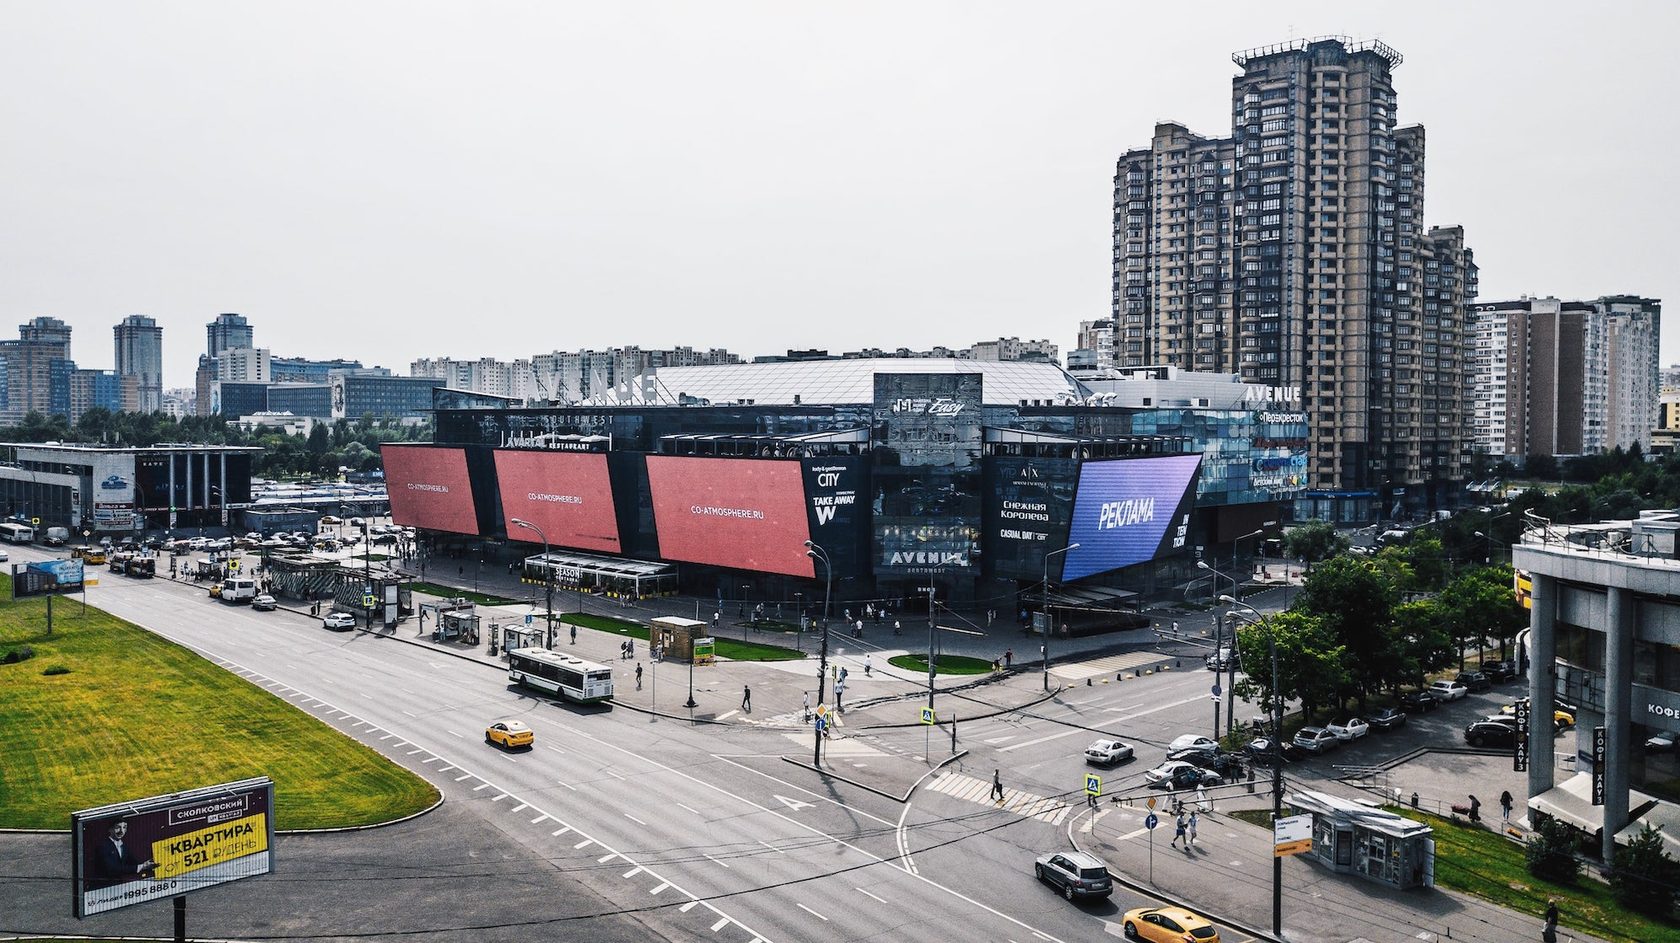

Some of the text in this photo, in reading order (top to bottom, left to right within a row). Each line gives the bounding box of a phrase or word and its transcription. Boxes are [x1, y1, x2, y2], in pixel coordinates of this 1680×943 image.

[1245, 387, 1301, 402] AVENUE
[928, 398, 965, 416] Easy
[544, 415, 614, 425] SOUTHWEST
[818, 473, 840, 487] CITY
[407, 483, 449, 493] CO-ATMOSPHERE.RU
[528, 492, 582, 504] CO-ATMOSPHERE.RU
[813, 496, 856, 506] TAKE AWAY
[690, 505, 764, 519] CO-ATMOSPHERE.RU
[1003, 500, 1047, 511] Снежная
[1001, 510, 1049, 521] Королева
[1099, 498, 1155, 530] РЕКЛАМА
[1000, 529, 1021, 540] CASUAL
[1022, 531, 1033, 540] DAY
[1177, 525, 1187, 536] TEN
[890, 552, 963, 564] AVENUE
[1647, 703, 1680, 719] КОФЕ
[1517, 703, 1526, 771] КОФЕ ХАУЗ
[1596, 731, 1605, 804] КОФЕ ХАУЗ
[176, 799, 243, 819] СКОЛКОВСКИЙ
[184, 850, 209, 867] 521
